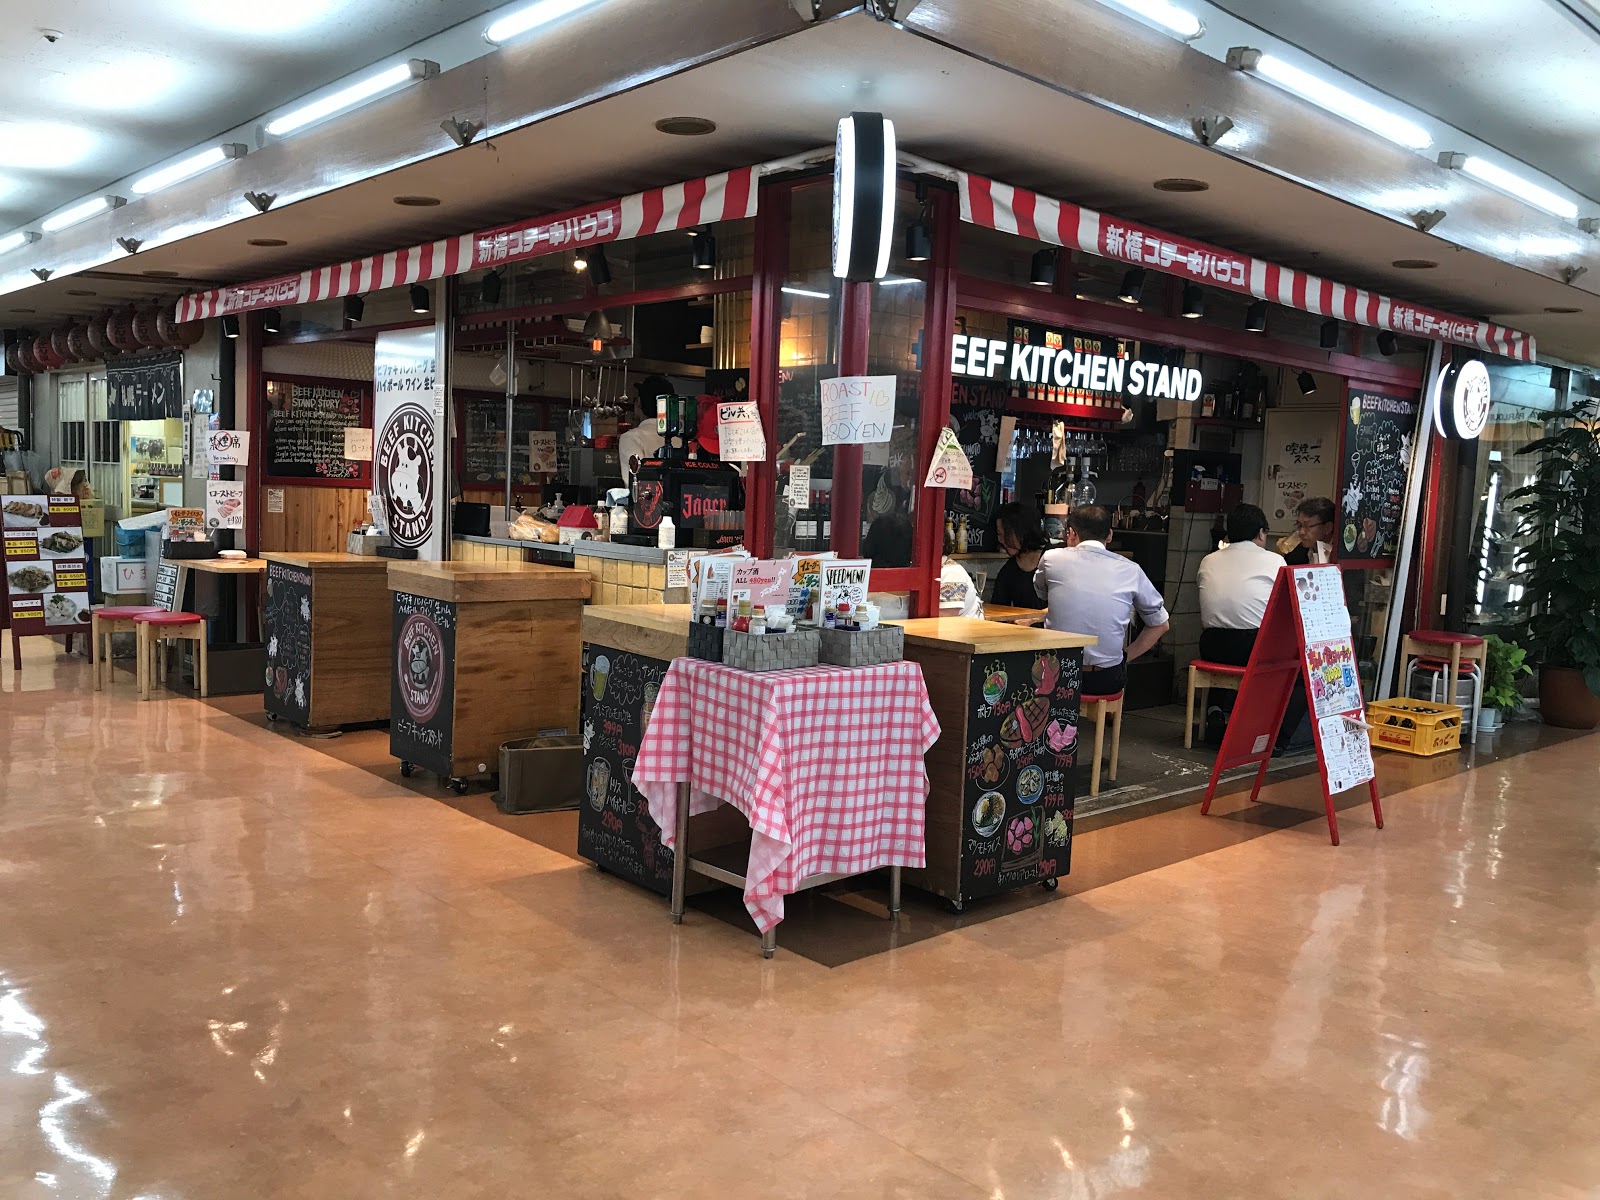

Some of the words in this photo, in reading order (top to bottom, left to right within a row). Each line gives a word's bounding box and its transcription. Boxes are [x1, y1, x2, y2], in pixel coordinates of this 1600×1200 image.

[1106, 224, 1245, 287] 新橋ステーキハウス
[951, 334, 1007, 378] EEF
[1010, 343, 1126, 393] KITCHEN
[1127, 360, 1203, 402] STAND
[292, 385, 312, 398] BEEF
[406, 377, 422, 391] ワイン
[822, 381, 872, 401] ROAST
[292, 398, 316, 408] STAND
[318, 399, 340, 409] STORY
[291, 410, 317, 419] KITCHEN
[824, 403, 862, 424] BEEF
[209, 435, 241, 451] 禁煙席
[380, 421, 399, 468] BEEF
[403, 414, 435, 473] KITCHE
[1285, 441, 1309, 455] 喫煙
[1294, 454, 1321, 464] スペース
[391, 514, 427, 538] STAND
[736, 568, 759, 576] カップ酒
[410, 689, 430, 704] STAND
